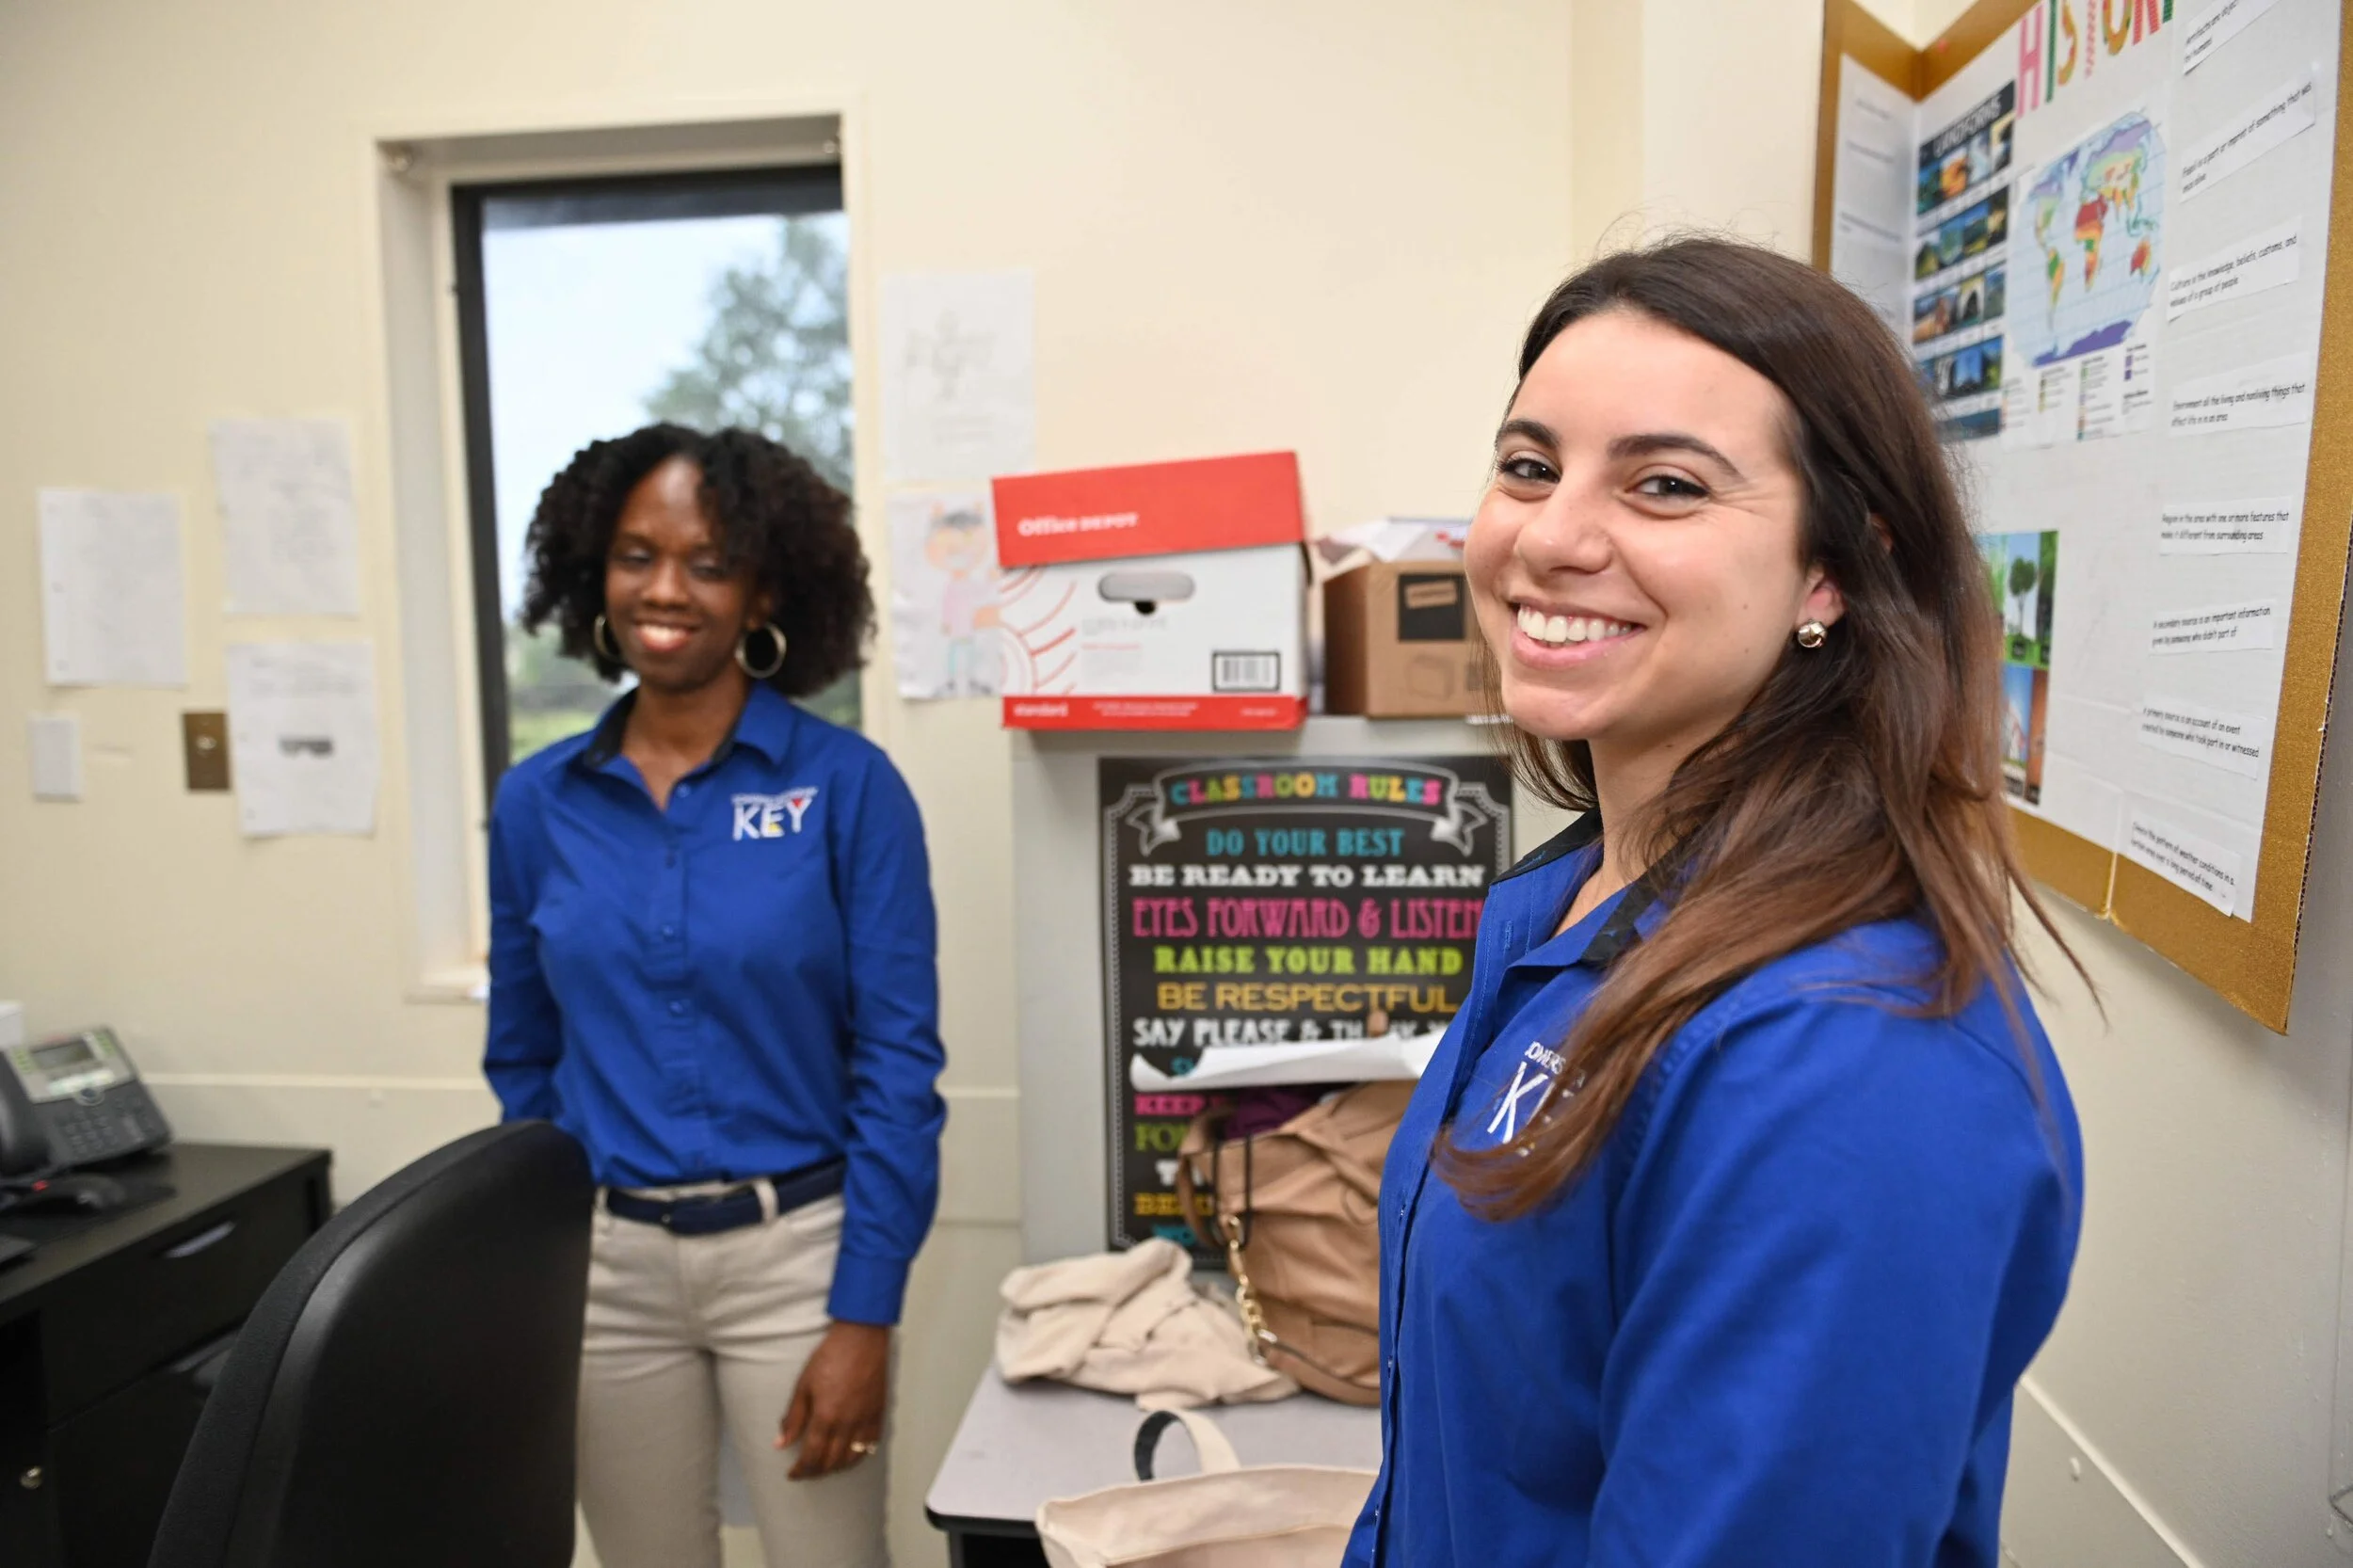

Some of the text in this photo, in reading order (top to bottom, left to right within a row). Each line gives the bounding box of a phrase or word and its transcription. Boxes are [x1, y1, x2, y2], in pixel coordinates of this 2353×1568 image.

[2016, 0, 2173, 120] HISTO
[2256, 103, 2286, 128] something
[2287, 90, 2300, 106] that
[2285, 234, 2297, 247] and
[2235, 392, 2245, 402] and
[2271, 387, 2291, 399] things
[2291, 383, 2305, 393] that
[1017, 515, 1078, 537] Office
[2249, 511, 2276, 521] features
[2276, 512, 2289, 520] that
[2212, 612, 2236, 622] important
[2237, 608, 2270, 618] information
[2230, 626, 2238, 637] of
[2225, 726, 2241, 734] event
[2232, 745, 2259, 758] witnessed
[1171, 772, 1441, 806] CLASSROOM RULES
[732, 798, 812, 840] KEY
[1207, 828, 1404, 856] DO YOUR BEST
[1128, 864, 1485, 887] BE READY TO LEARN
[1132, 898, 1199, 937] EYES
[1208, 898, 1350, 937] FORWARD
[1357, 899, 1382, 937] &
[1154, 946, 1464, 975] RAISE YOUR HAND
[1158, 983, 1459, 1013] BE RESPECTFUL
[1132, 1017, 1187, 1047] SAY
[1193, 1017, 1292, 1047] PLEASE
